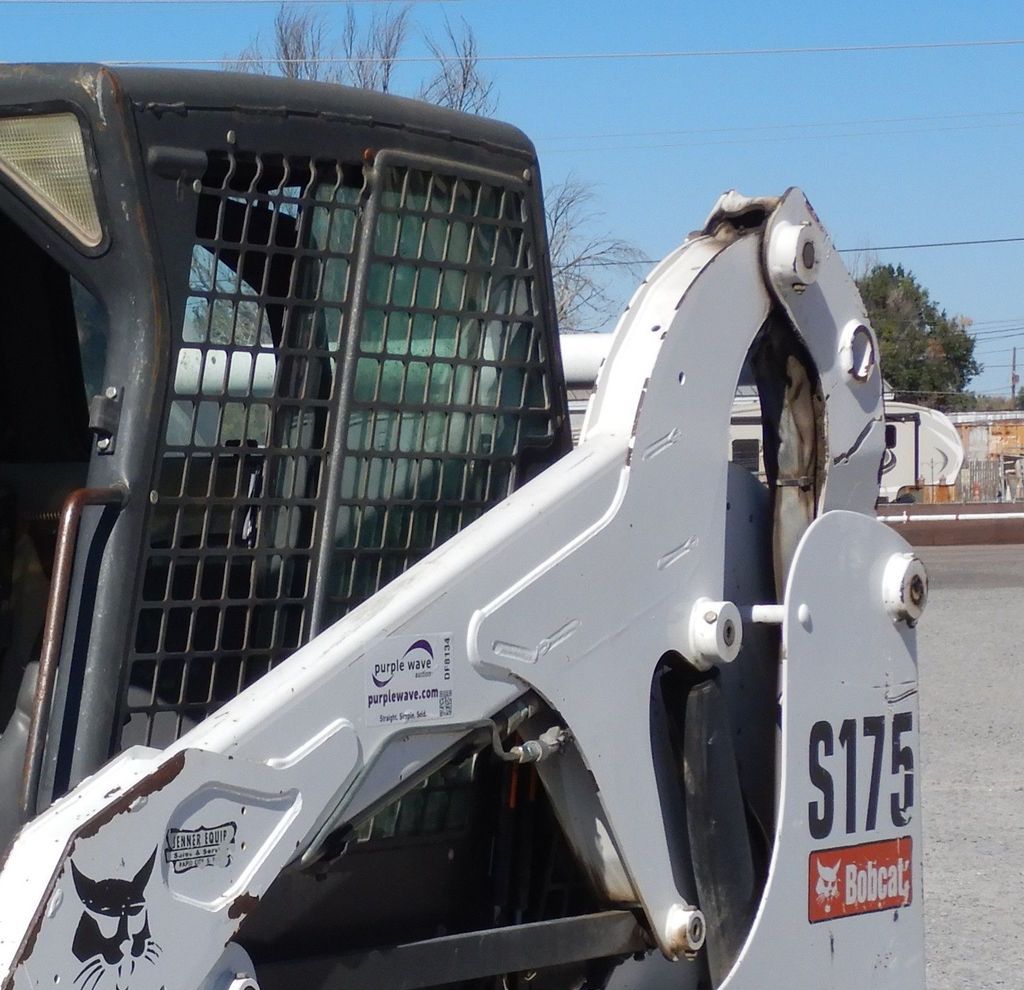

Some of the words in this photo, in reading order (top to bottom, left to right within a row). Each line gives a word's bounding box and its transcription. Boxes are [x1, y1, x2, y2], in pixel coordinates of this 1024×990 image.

[374, 659, 404, 676] purple
[408, 659, 431, 670] wave
[368, 688, 439, 708] purplewave.com
[808, 712, 914, 839] S175
[172, 832, 201, 848] JENNER
[845, 858, 907, 905] Bobcat
